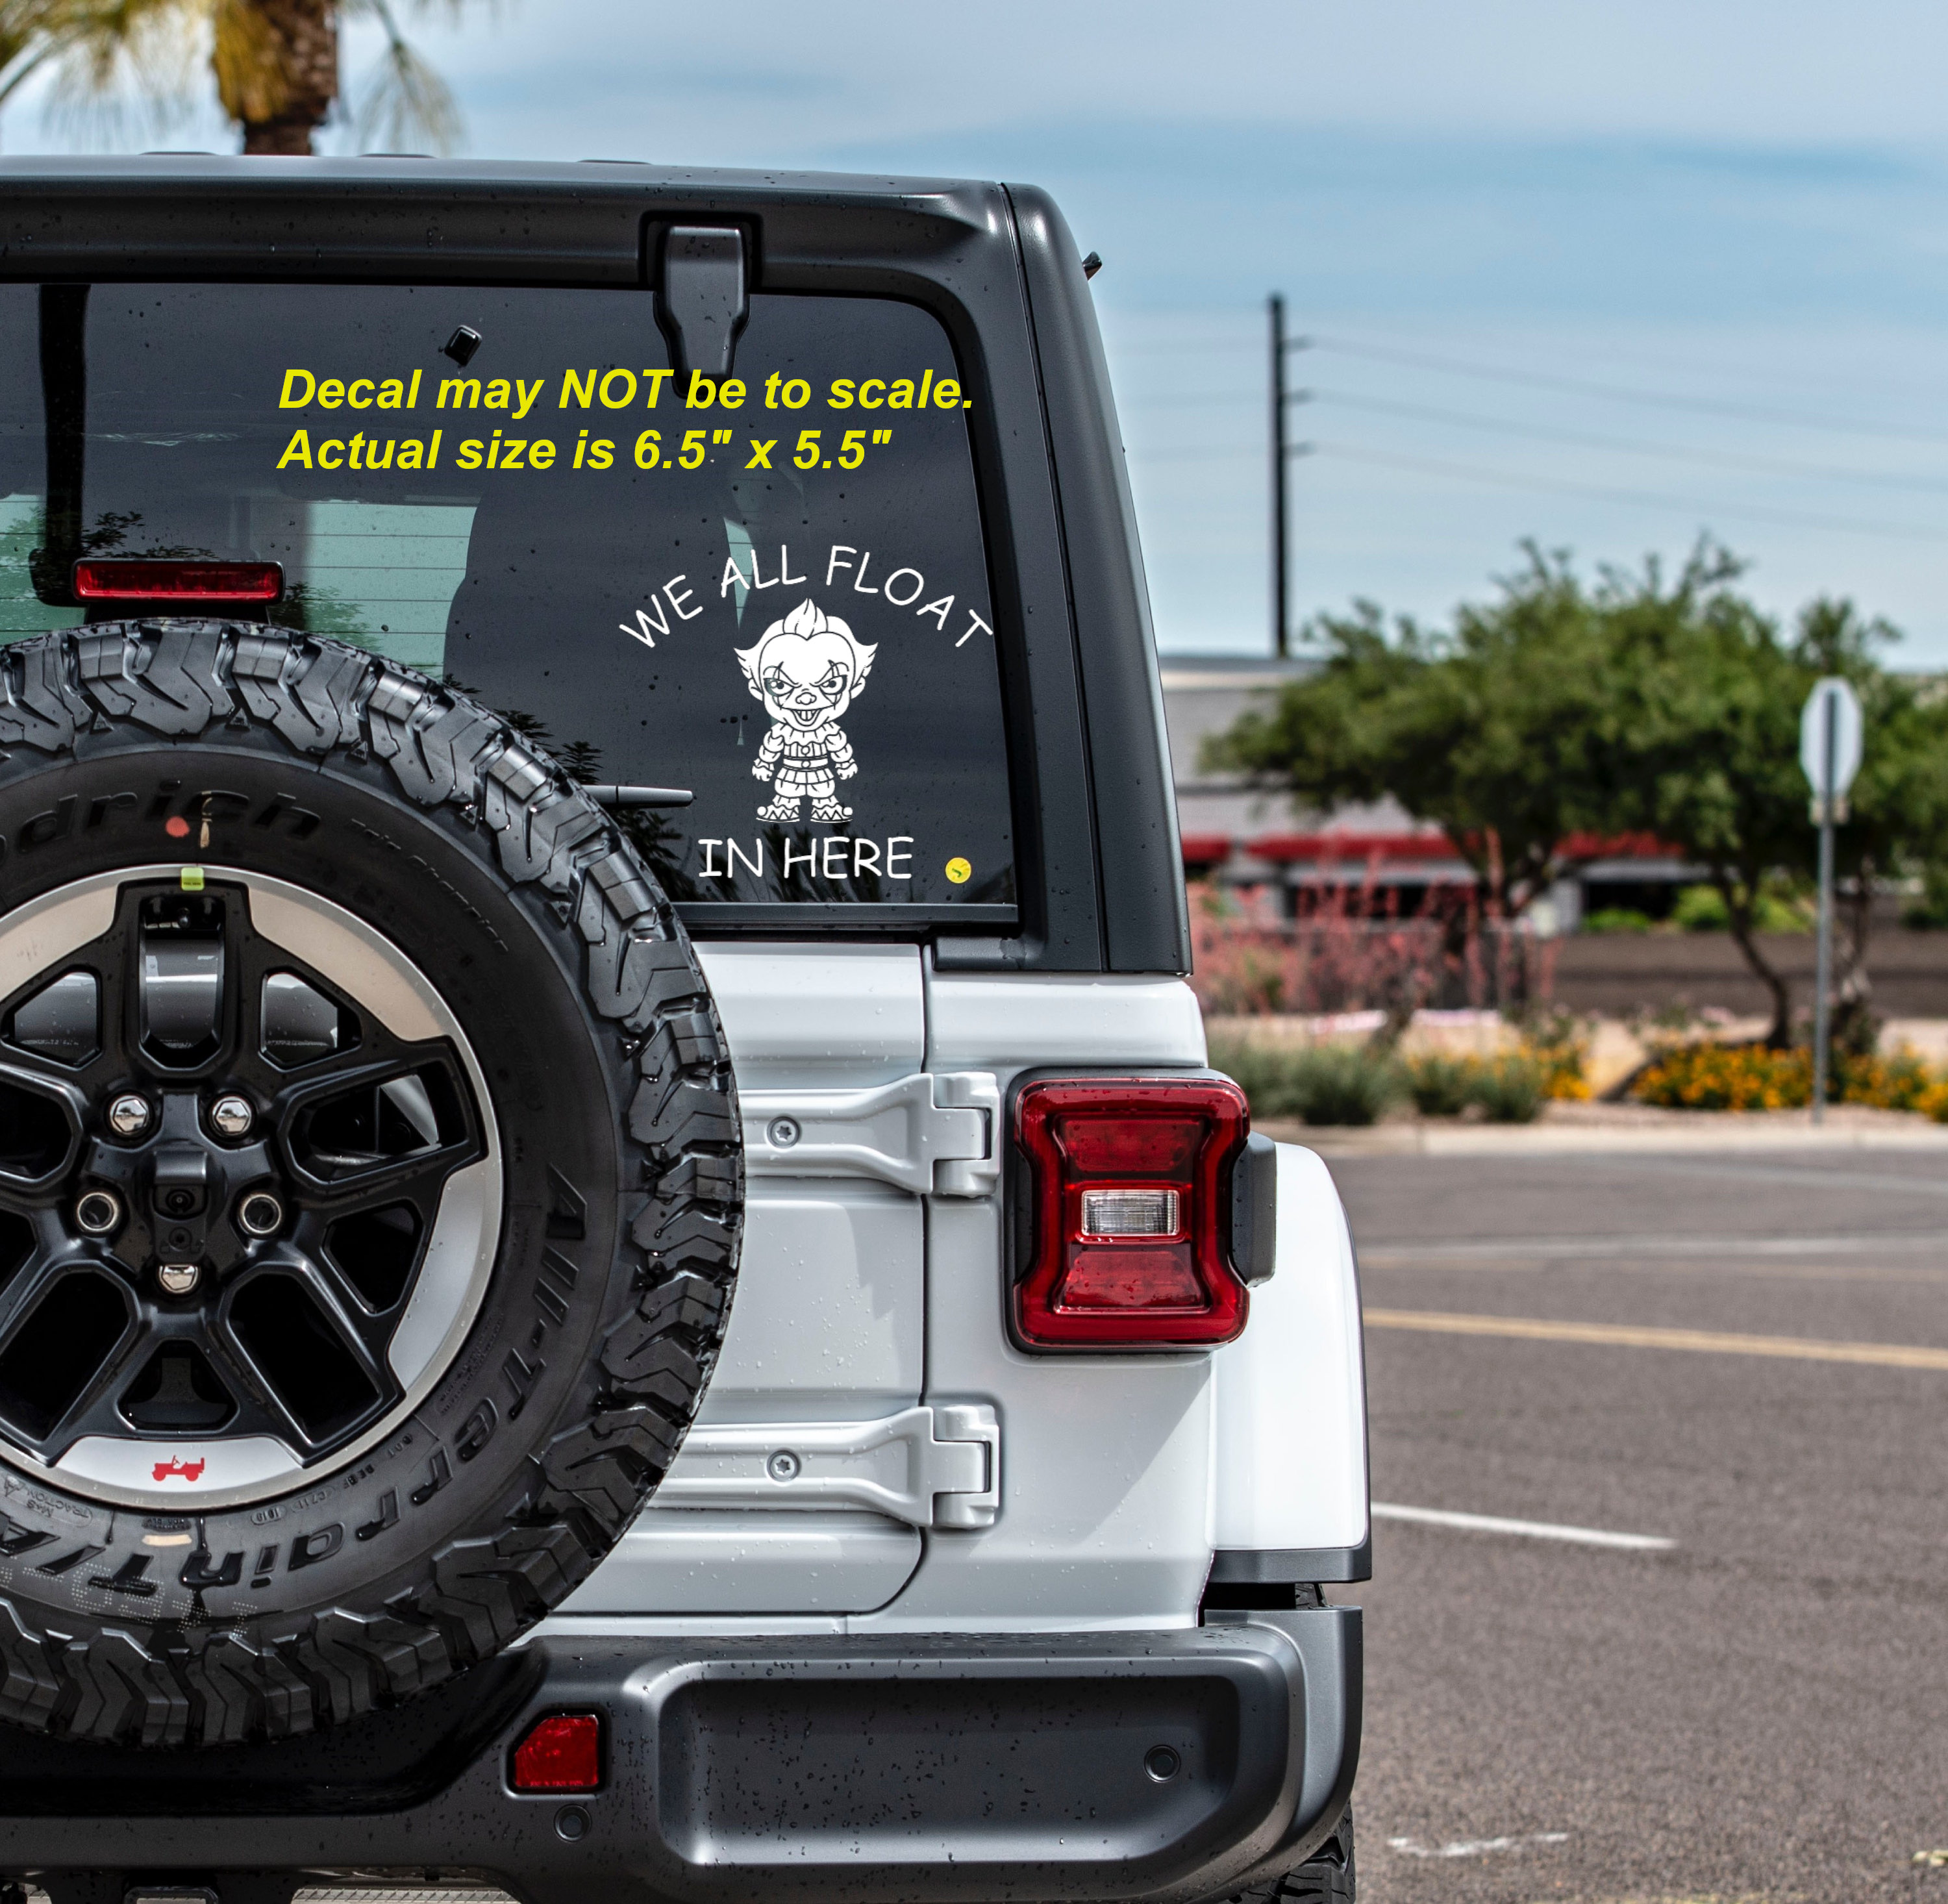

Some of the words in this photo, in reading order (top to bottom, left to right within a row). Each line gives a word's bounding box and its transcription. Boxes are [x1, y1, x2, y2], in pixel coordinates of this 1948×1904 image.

[619, 574, 703, 648] WE
[721, 544, 807, 598] ALL
[826, 545, 993, 647] FLOAT
[0, 779, 321, 858] drich
[698, 838, 763, 878] IN
[784, 836, 914, 879] HERE
